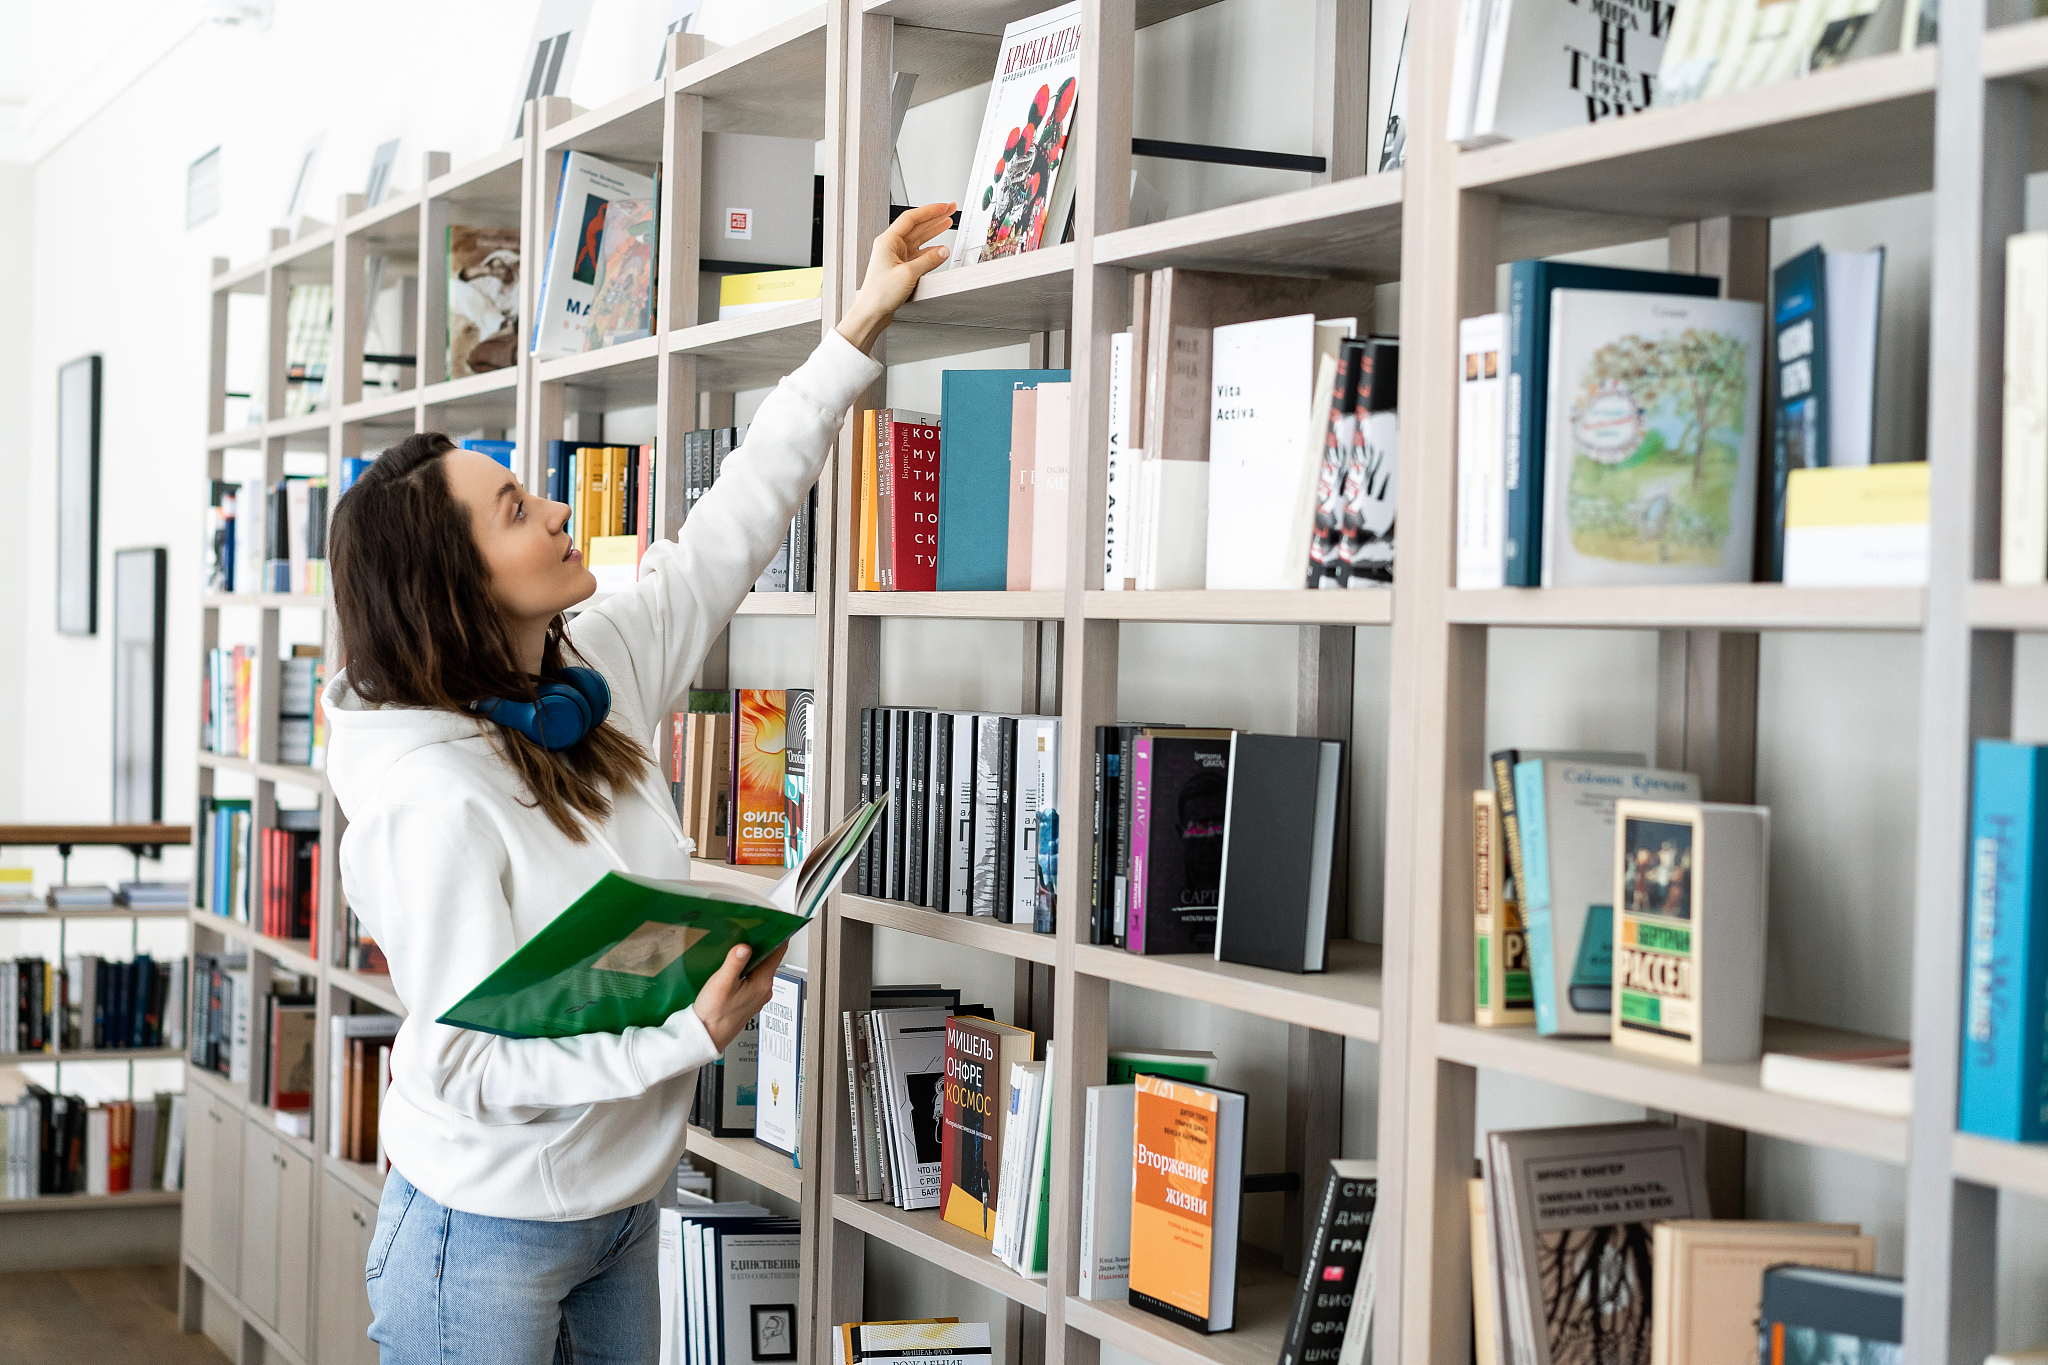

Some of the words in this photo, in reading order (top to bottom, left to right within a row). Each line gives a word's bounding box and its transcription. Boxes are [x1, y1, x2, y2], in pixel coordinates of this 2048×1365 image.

[1004, 35, 1048, 75] КРАСКИ
[1046, 24, 1081, 61] КИТАЯ
[757, 280, 796, 291] ФИЛОСОФИЯ
[1217, 385, 1241, 398] Vita
[901, 427, 909, 452] Гройс
[901, 453, 909, 480] Борис
[913, 450, 936, 463] МУ
[1109, 432, 1119, 484] Vita
[913, 491, 936, 503] КИ
[914, 512, 939, 524] ПО
[914, 533, 936, 545] СК
[1105, 494, 1117, 574] Activa
[914, 554, 937, 568] ТУ
[742, 826, 785, 839] СВОБ
[1118, 801, 1126, 841] МОДЕЛЬ
[859, 838, 867, 886] РЦЕН
[872, 831, 880, 888] ГЕРЦЕН
[947, 1028, 994, 1060] МИШЕЛЬ
[946, 1057, 983, 1087] ОНФРЕ
[946, 1081, 992, 1116] КОСМОС
[917, 1166, 930, 1174] ЧТО
[1138, 1143, 1209, 1185] Вторжение
[1165, 1187, 1207, 1216] жизни
[902, 1349, 933, 1357] МИШЕЛЬ
[933, 1348, 953, 1356] ФУКО
